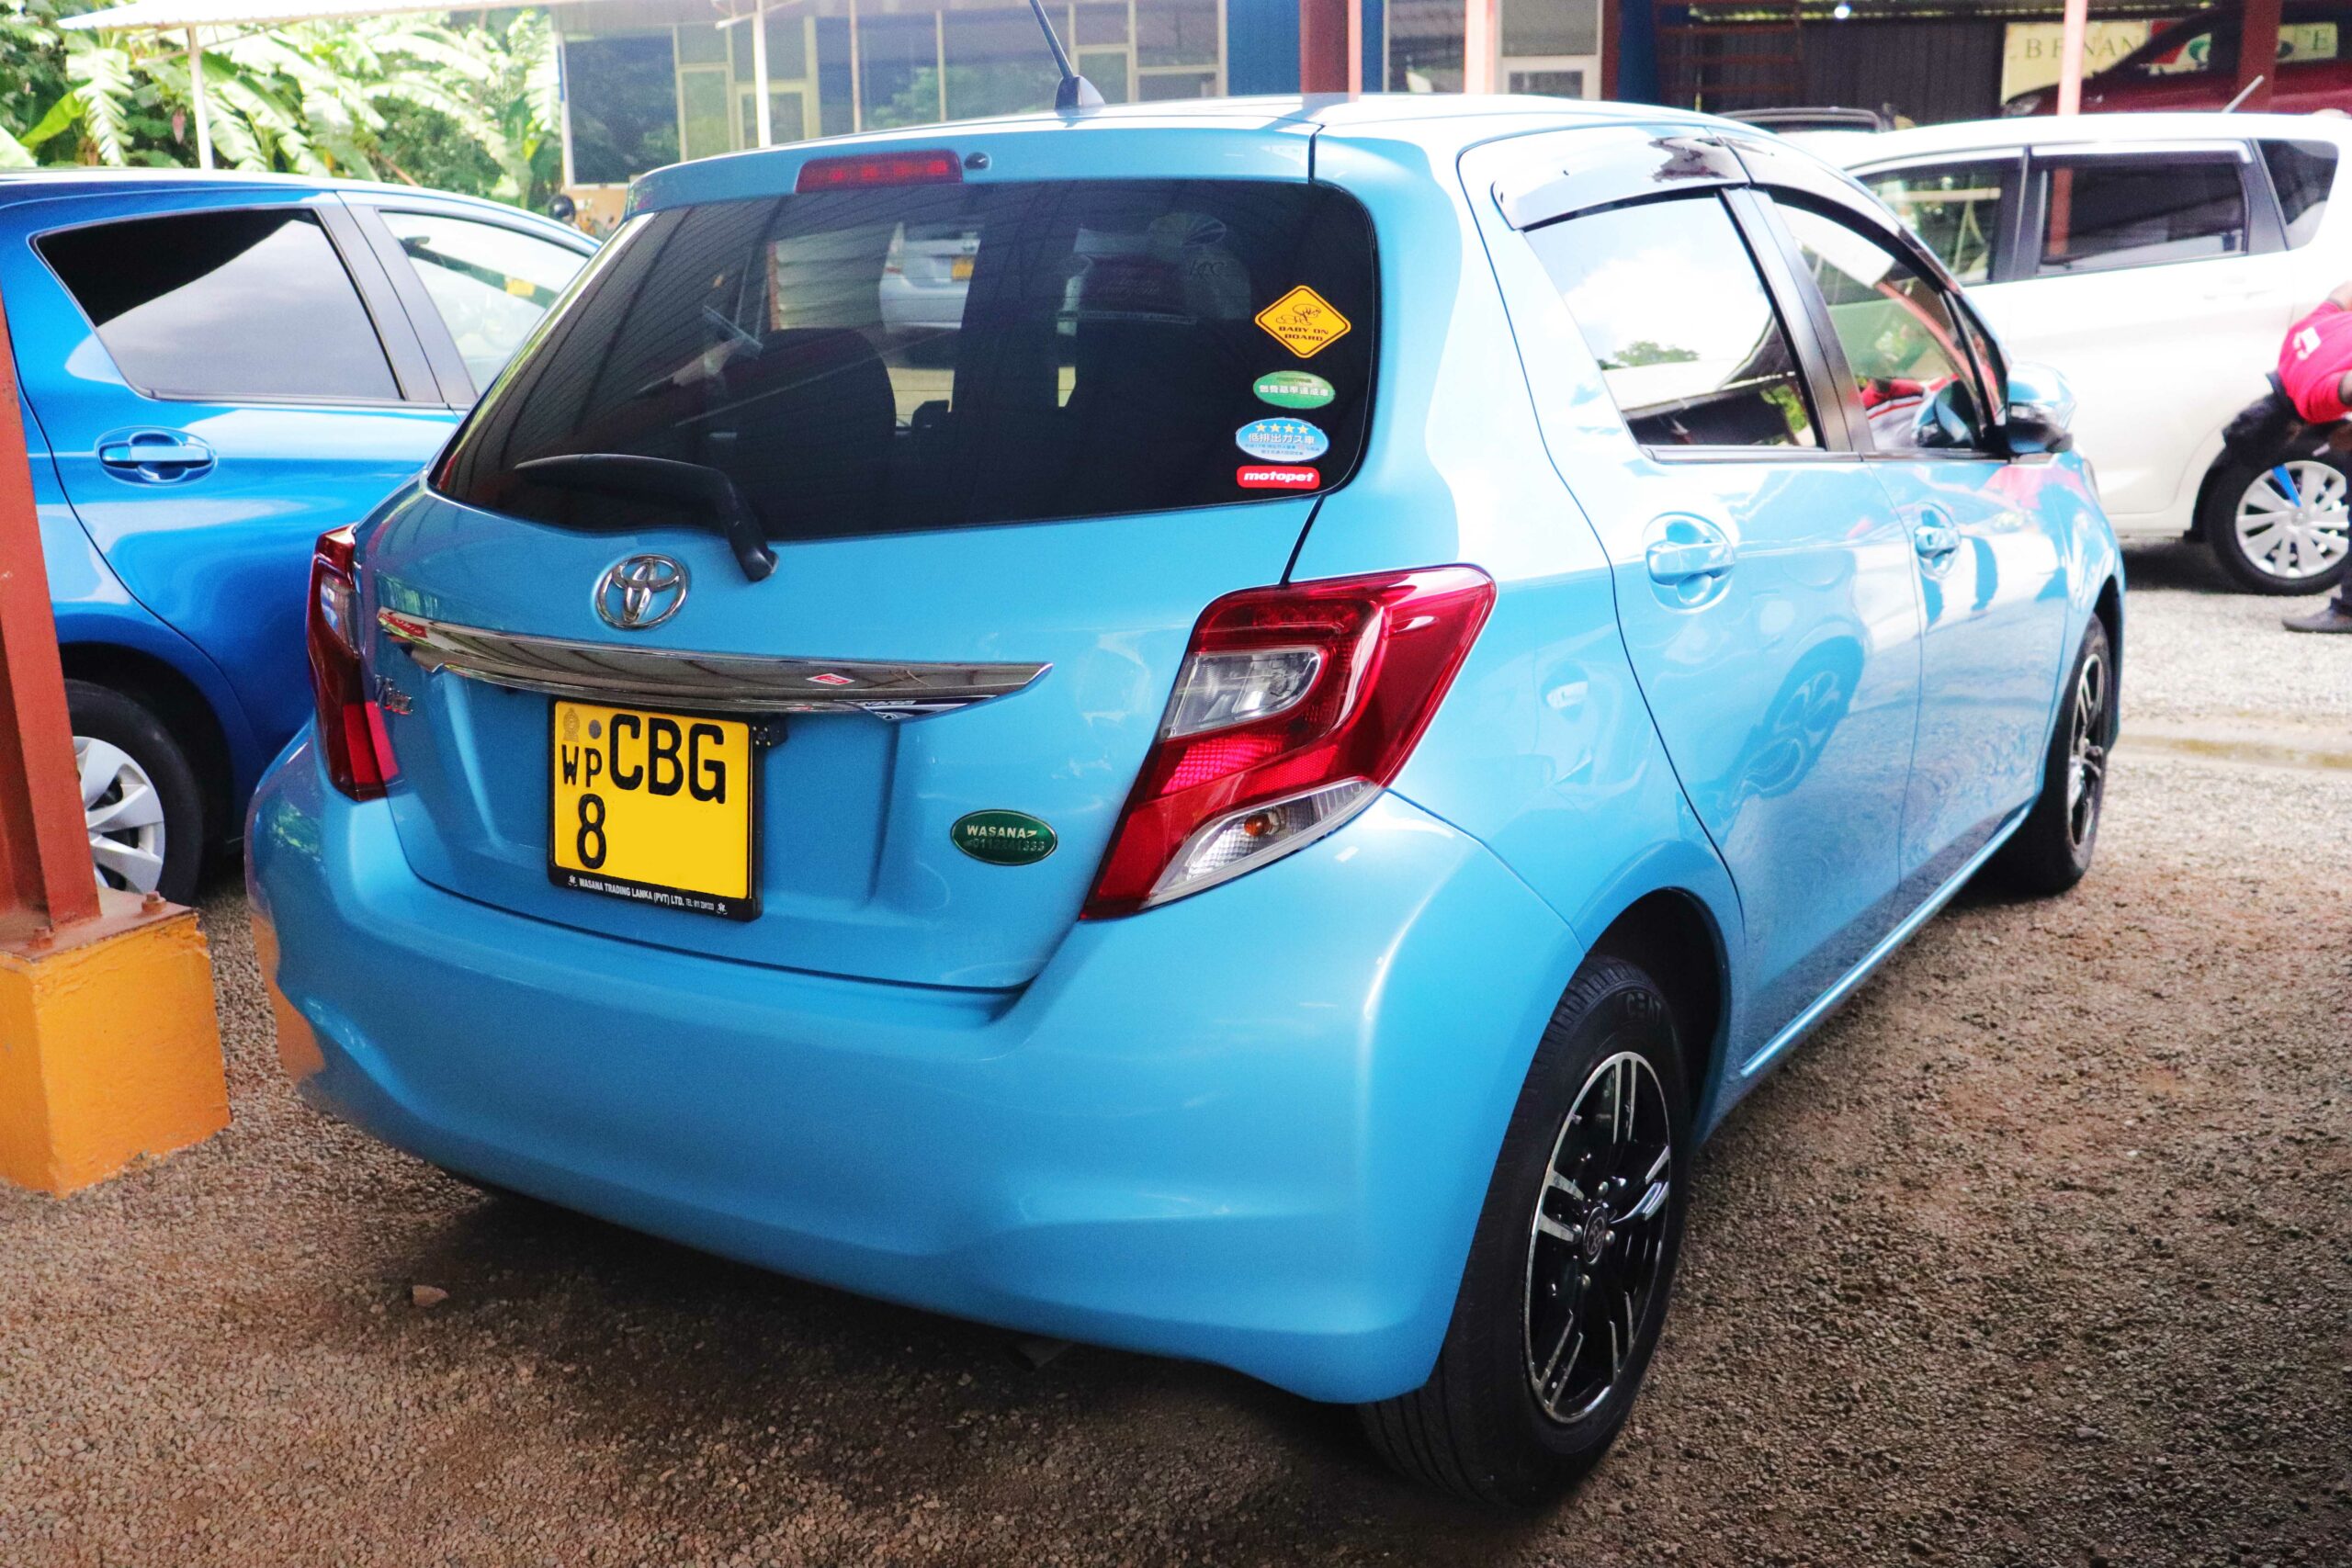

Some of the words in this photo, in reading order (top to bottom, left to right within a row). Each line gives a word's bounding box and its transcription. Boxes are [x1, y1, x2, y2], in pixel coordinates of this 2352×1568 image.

[1244, 470, 1314, 483] motopet
[561, 744, 603, 787] WP
[610, 714, 726, 804] CBG
[577, 794, 607, 870] 8
[967, 824, 1026, 839] WASANA
[579, 878, 604, 891] WASANA
[605, 883, 631, 897] TRADING
[631, 888, 652, 900] LANKA
[653, 892, 670, 906] (PVT)
[671, 895, 684, 907] LTD.
